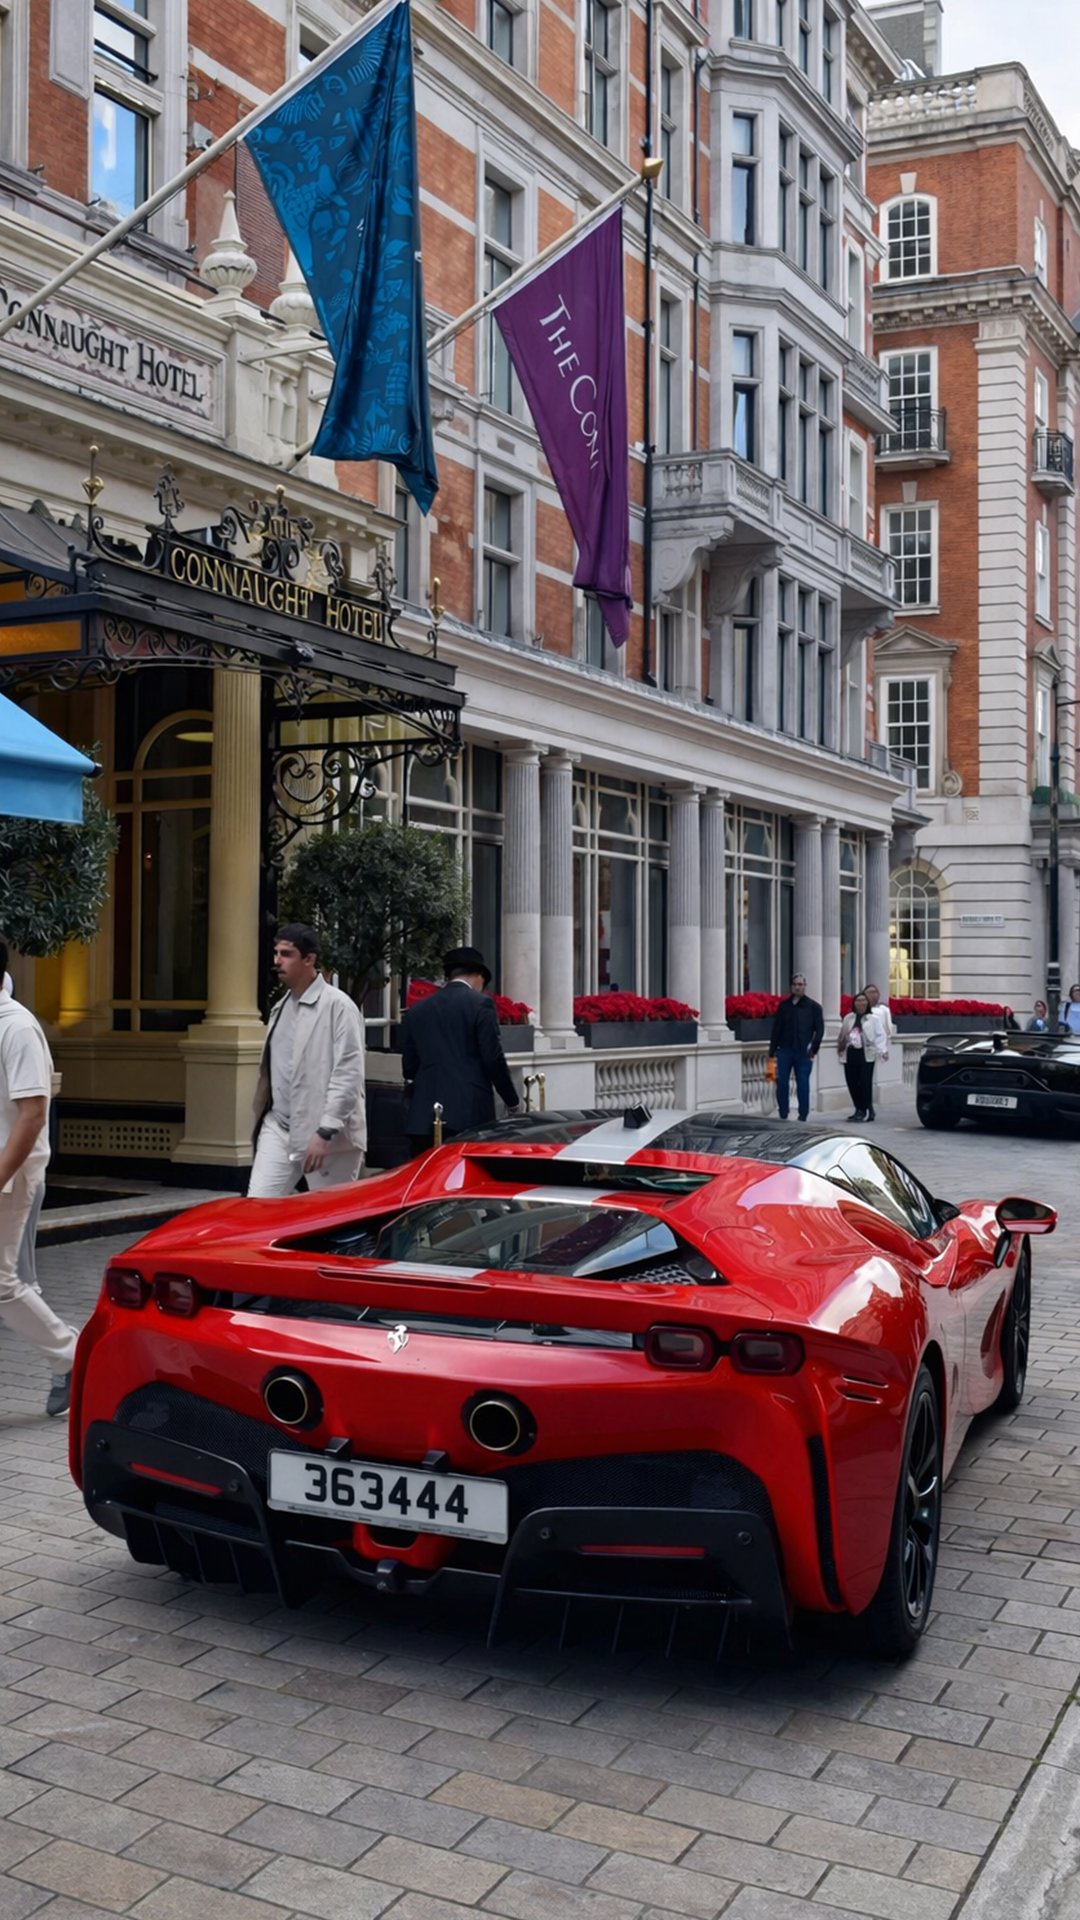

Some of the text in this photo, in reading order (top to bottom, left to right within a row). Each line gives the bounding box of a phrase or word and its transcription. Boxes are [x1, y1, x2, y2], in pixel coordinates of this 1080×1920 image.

[137, 342, 204, 402] HOTEL
[539, 294, 580, 378] THE
[171, 547, 383, 643] CONNAUGHT HOTEL
[305, 1463, 468, 1523] 363444
